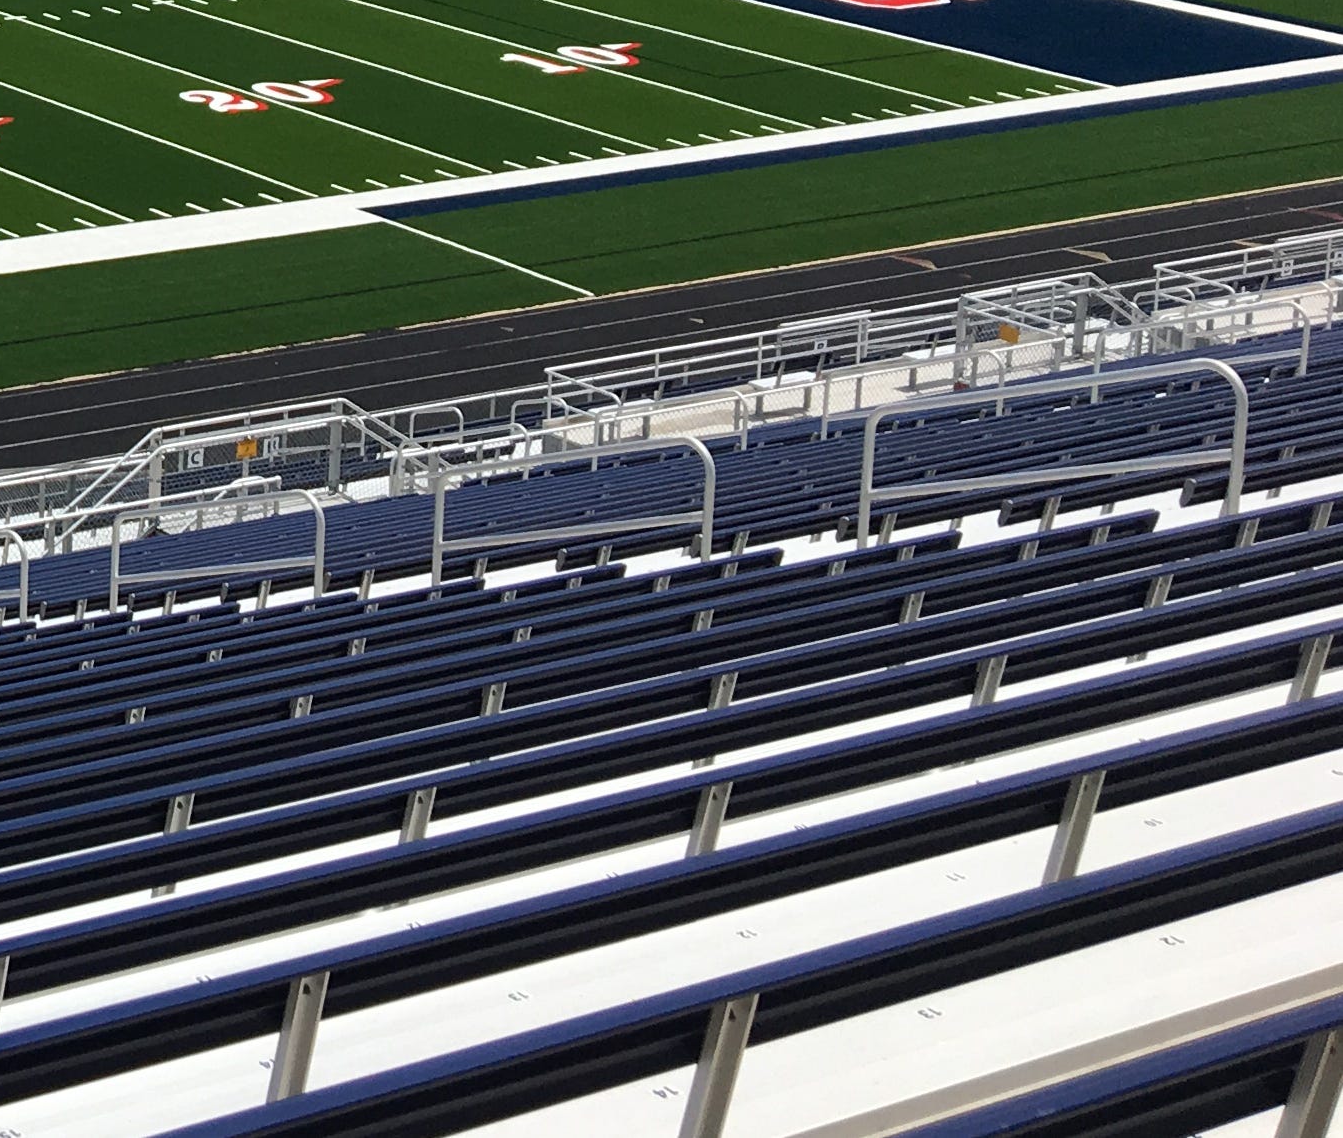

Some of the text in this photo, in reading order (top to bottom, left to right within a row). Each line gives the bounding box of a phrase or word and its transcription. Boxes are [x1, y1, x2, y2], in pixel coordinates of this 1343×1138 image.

[191, 451, 201, 465] C
[946, 872, 966, 882] 11
[737, 929, 758, 939] 12
[1160, 935, 1185, 946] 12
[508, 991, 529, 1002] 13
[917, 1007, 942, 1019] 13
[653, 1085, 679, 1099] 14
